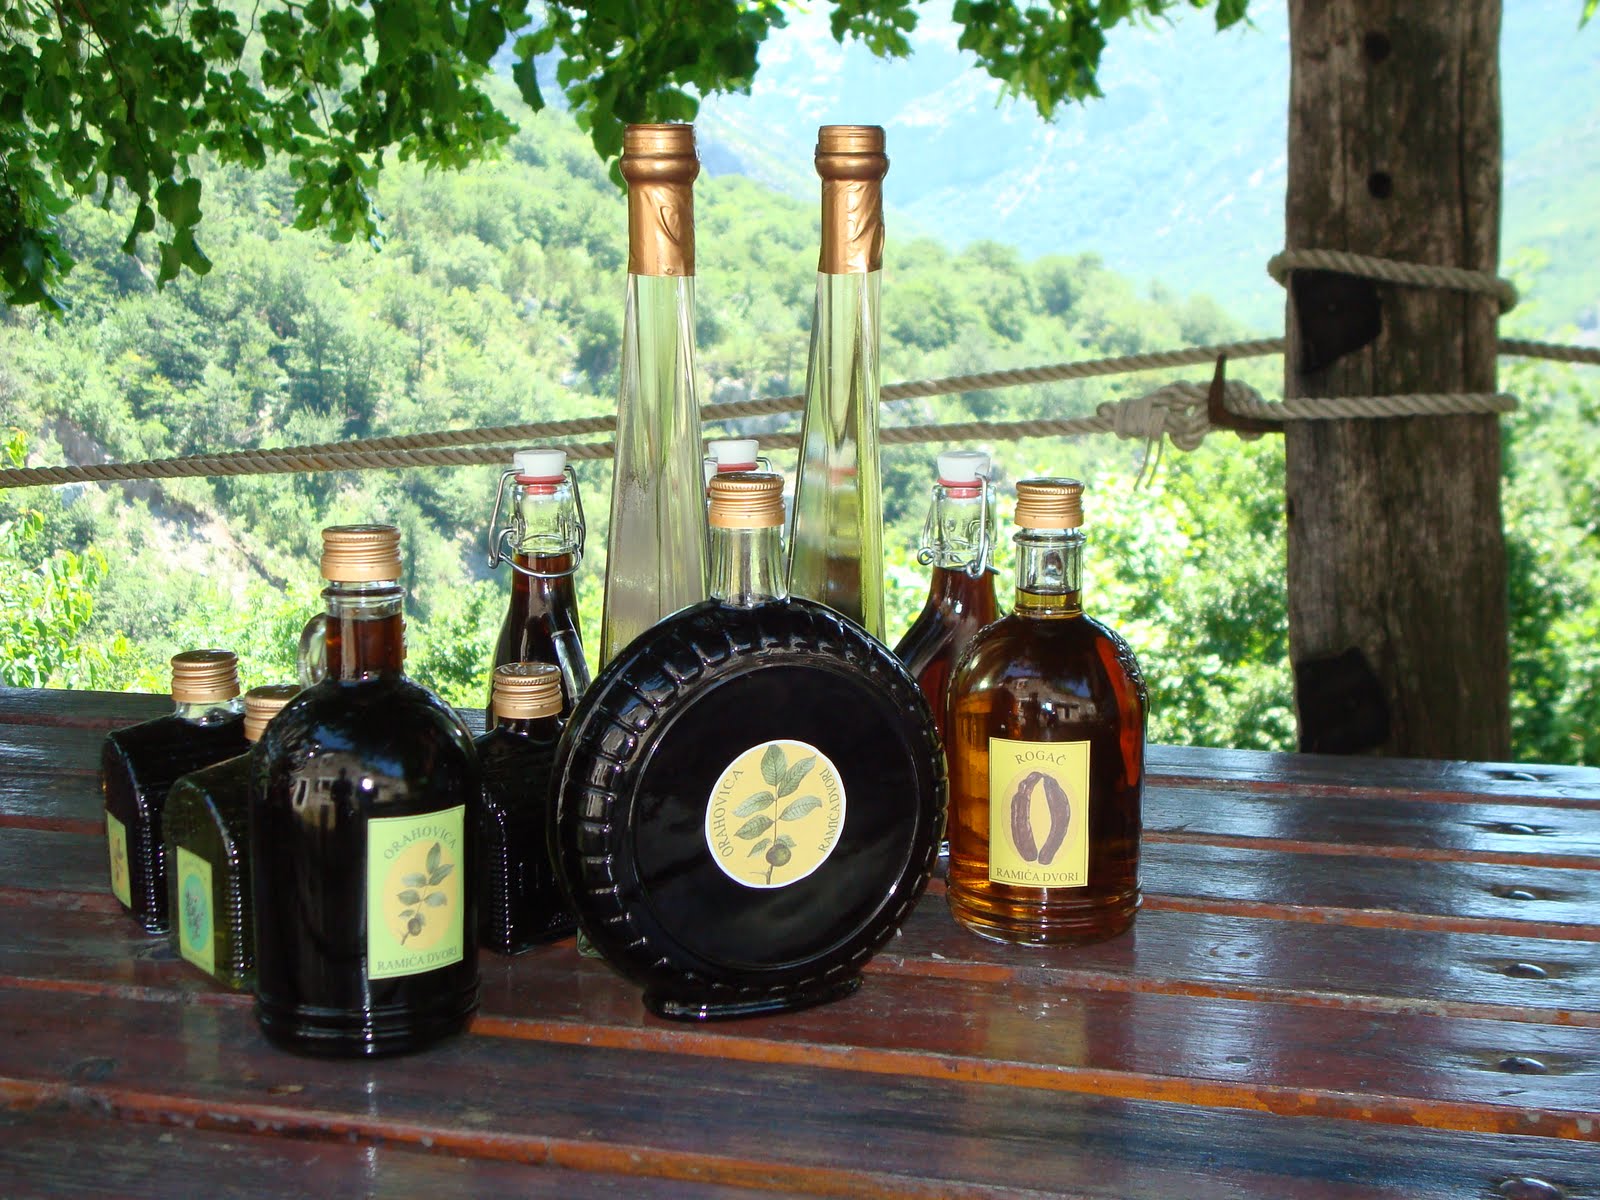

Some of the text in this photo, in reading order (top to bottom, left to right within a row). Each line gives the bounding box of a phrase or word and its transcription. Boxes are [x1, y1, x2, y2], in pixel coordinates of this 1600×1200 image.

[1015, 750, 1067, 766] ROGAČ
[819, 768, 840, 803] DVORI
[713, 769, 744, 858] ORAHOVICA
[384, 826, 457, 860] ORAHOVICA
[1043, 871, 1079, 882] DVORI
[427, 946, 457, 963] DVORI
